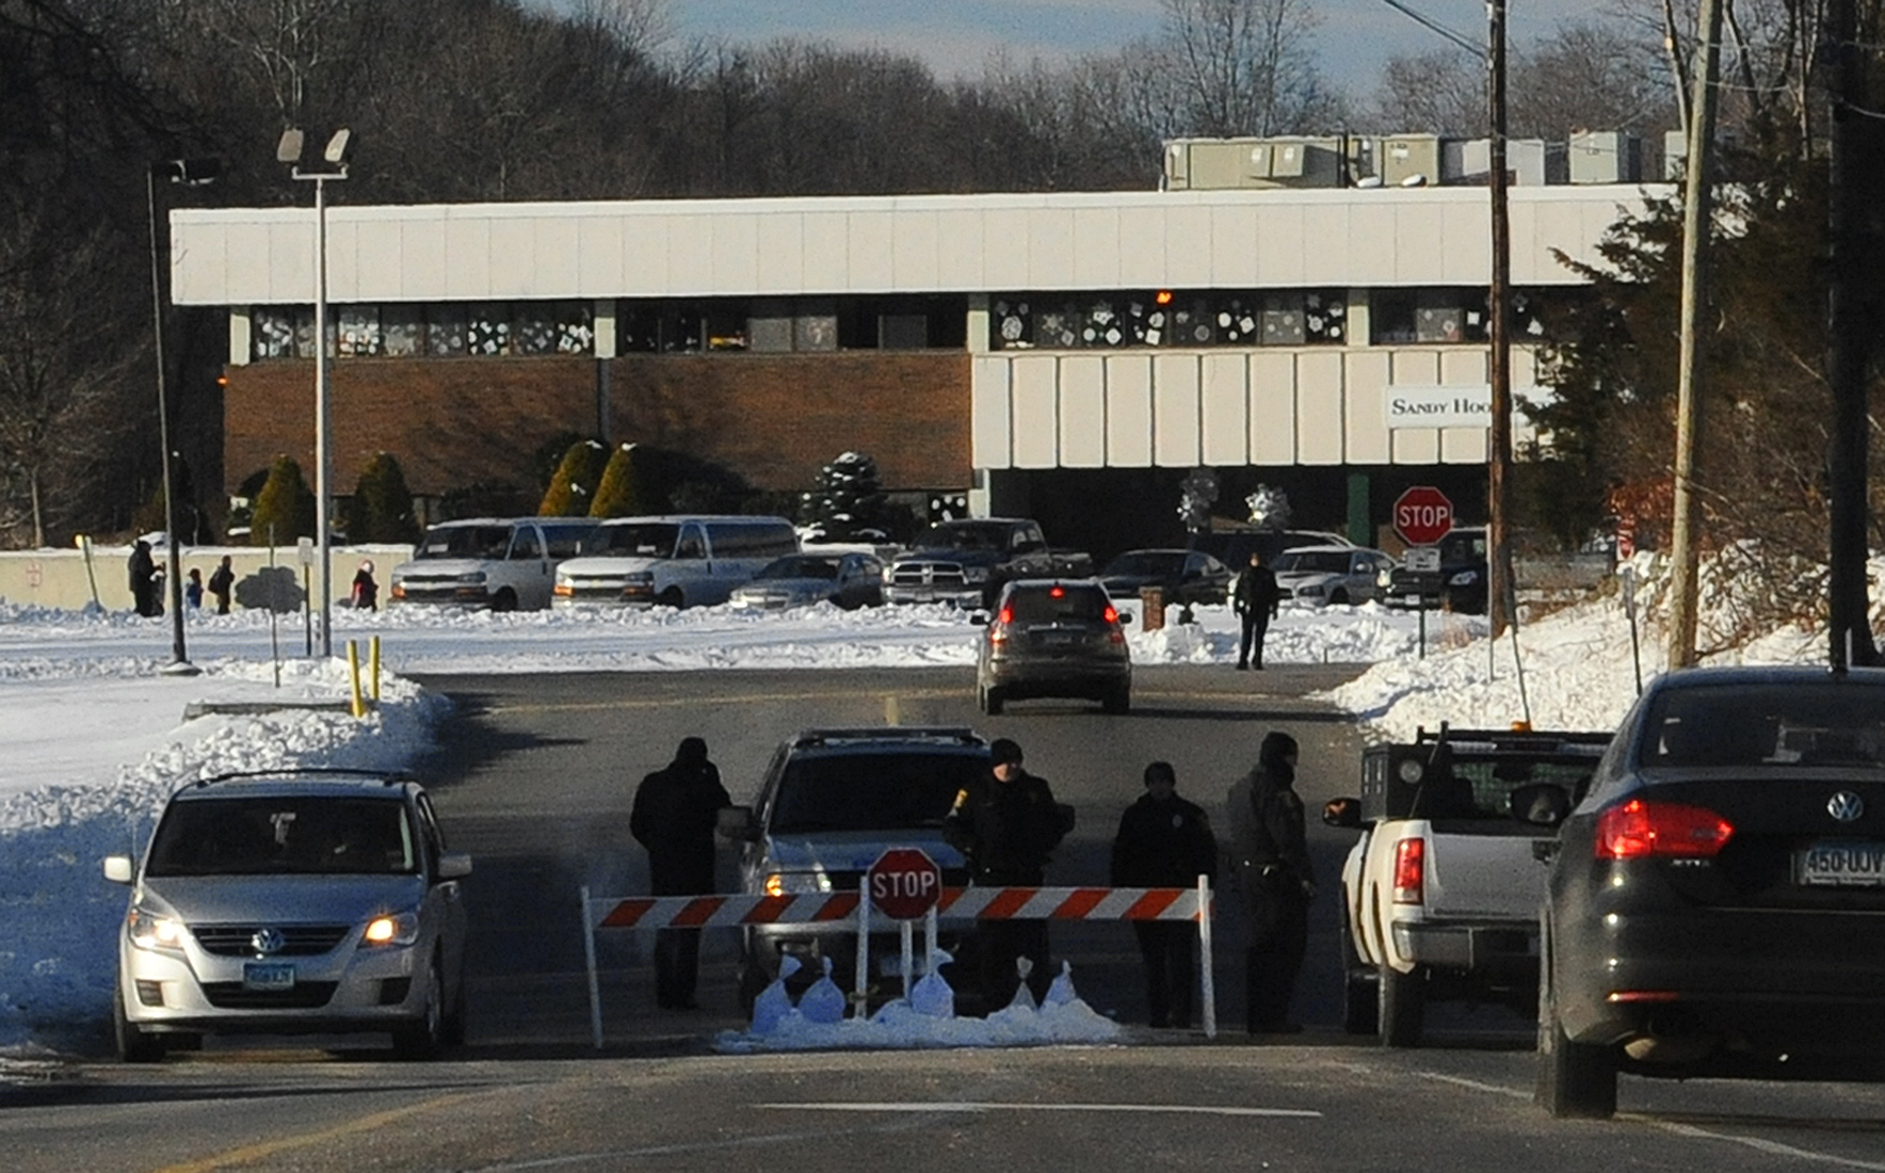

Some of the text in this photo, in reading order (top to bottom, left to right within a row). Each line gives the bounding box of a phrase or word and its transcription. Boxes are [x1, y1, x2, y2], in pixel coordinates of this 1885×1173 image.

[1392, 398, 1492, 415] SANDY HOO
[1399, 505, 1449, 528] STOP
[873, 870, 936, 899] STOP
